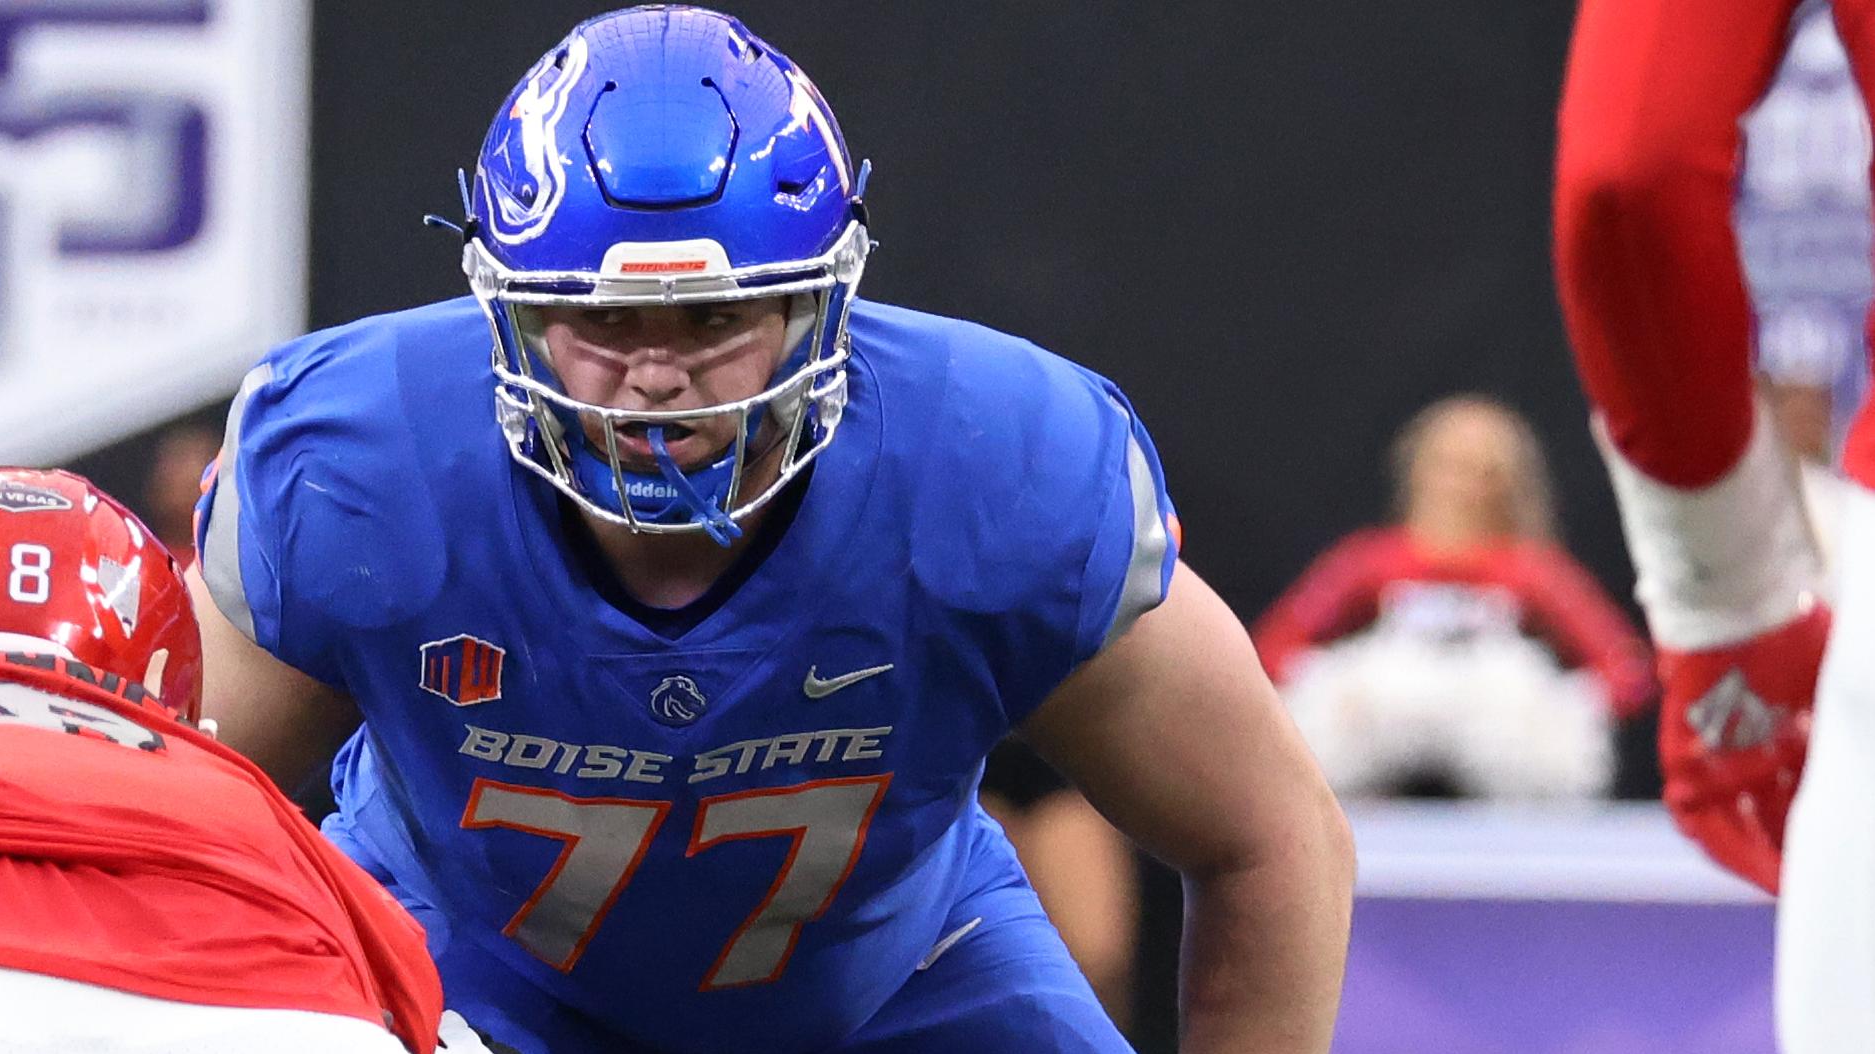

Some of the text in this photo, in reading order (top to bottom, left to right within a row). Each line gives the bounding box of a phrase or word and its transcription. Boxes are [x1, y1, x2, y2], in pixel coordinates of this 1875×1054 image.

[6, 492, 58, 506] VEGAS
[8, 543, 53, 605] 8
[458, 722, 893, 784] BOISE STATE
[458, 771, 894, 993] 77
